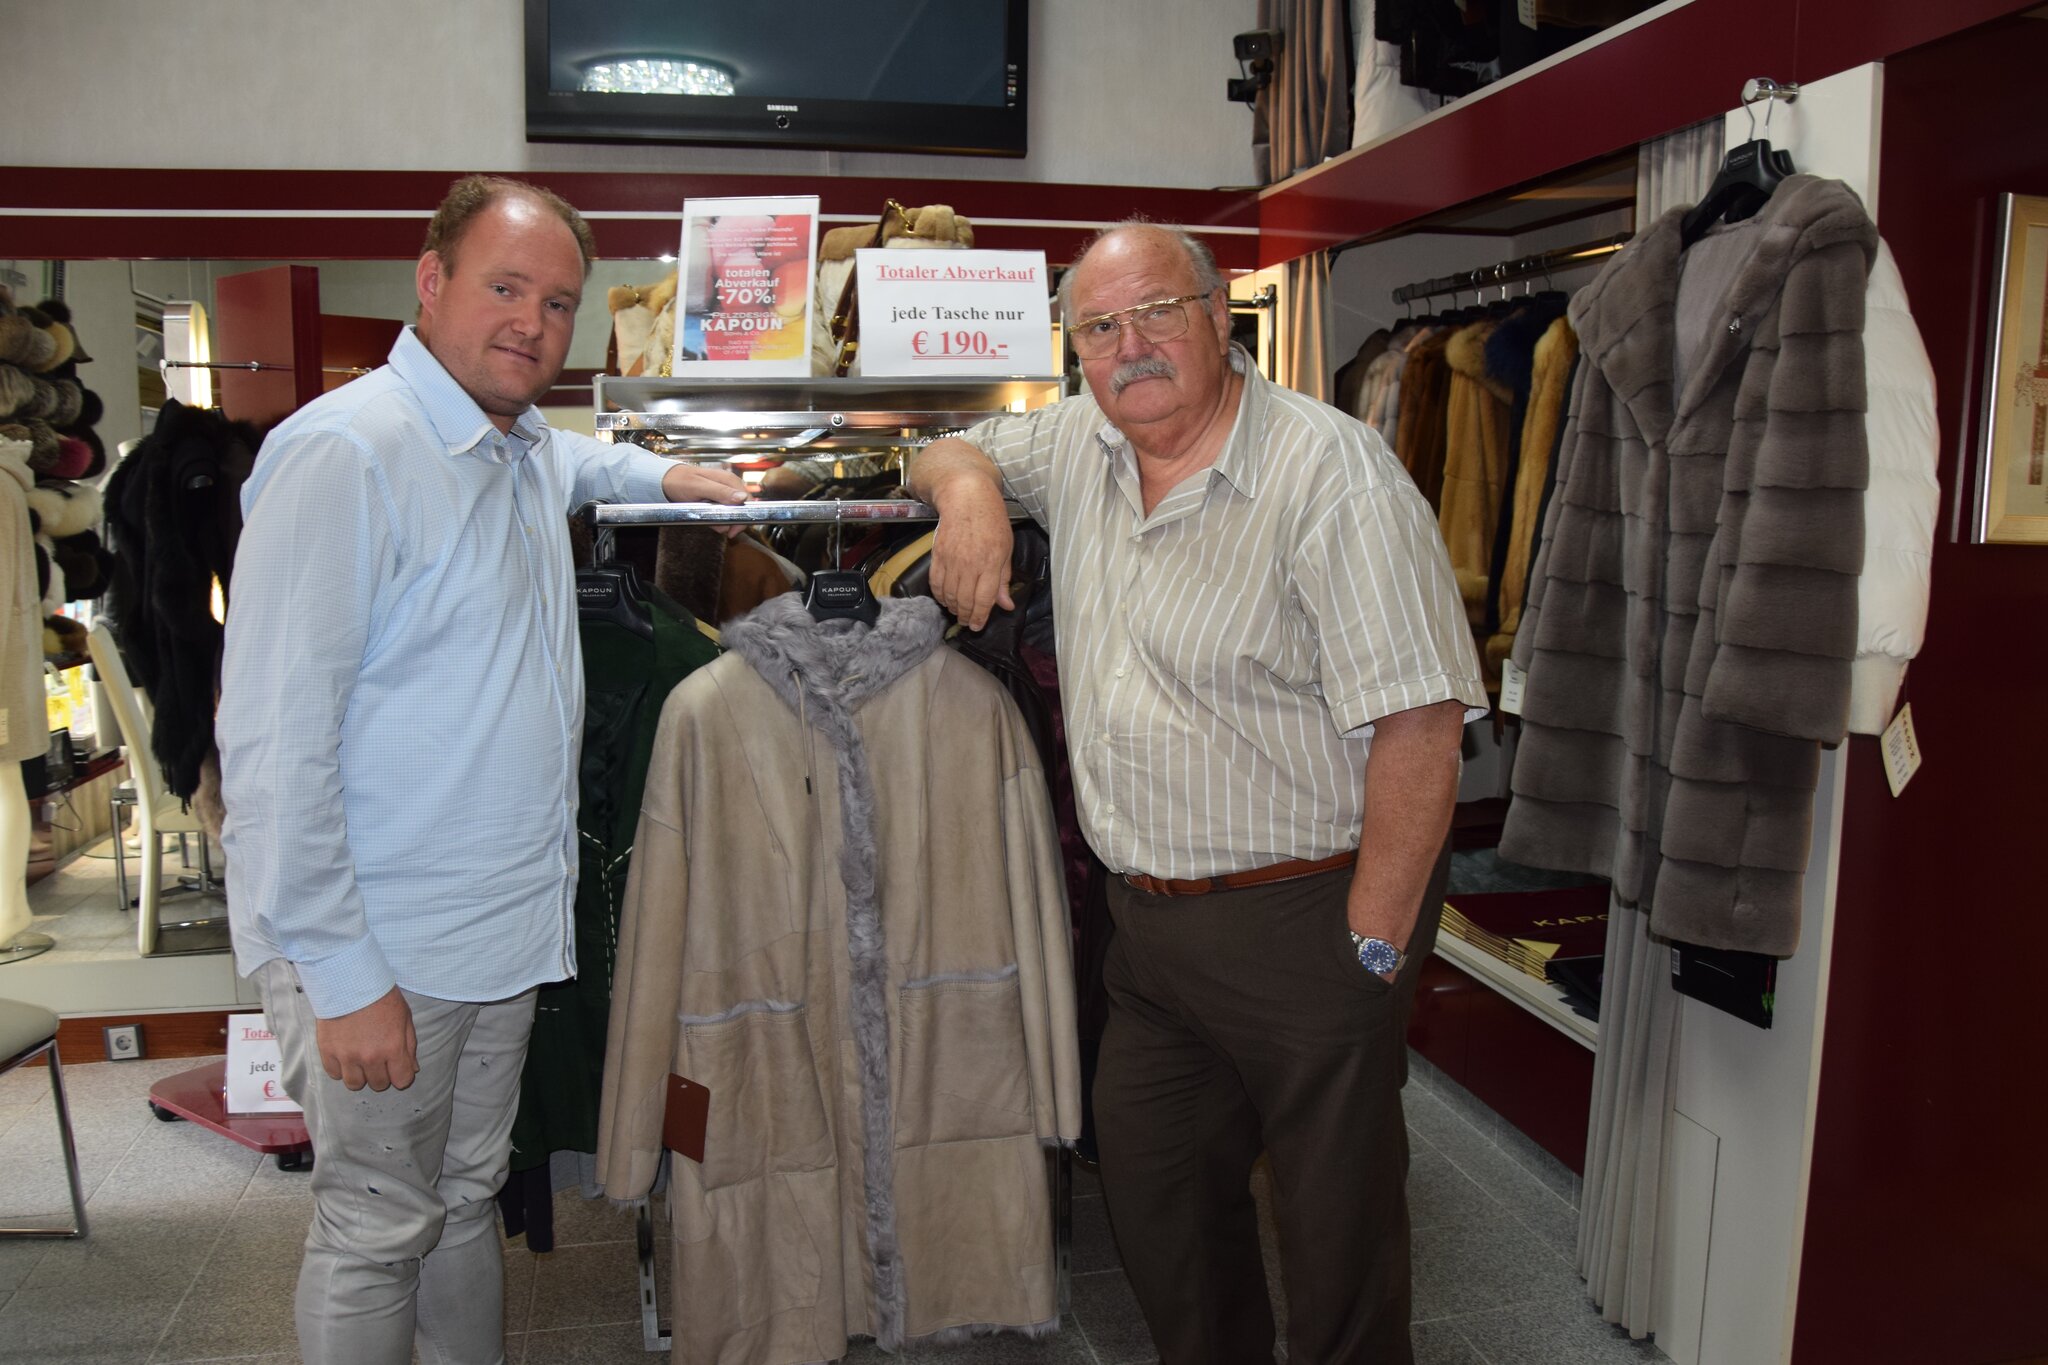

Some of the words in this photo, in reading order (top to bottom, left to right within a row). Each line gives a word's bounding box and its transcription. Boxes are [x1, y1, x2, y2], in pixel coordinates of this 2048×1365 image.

[725, 268, 770, 278] totalen
[876, 264, 939, 280] Totaler
[943, 265, 1036, 281] Abverkauf
[714, 277, 780, 288] Abverkauf
[716, 288, 776, 304] -70%!
[890, 306, 927, 323] jede
[932, 306, 990, 320] Tasche
[994, 310, 1025, 321] nur
[700, 318, 784, 331] KAPOUN
[911, 330, 929, 355] €
[938, 330, 1009, 359] 190,-
[242, 1027, 277, 1039] Tota
[249, 1061, 276, 1075] jede
[263, 1080, 276, 1097] €
